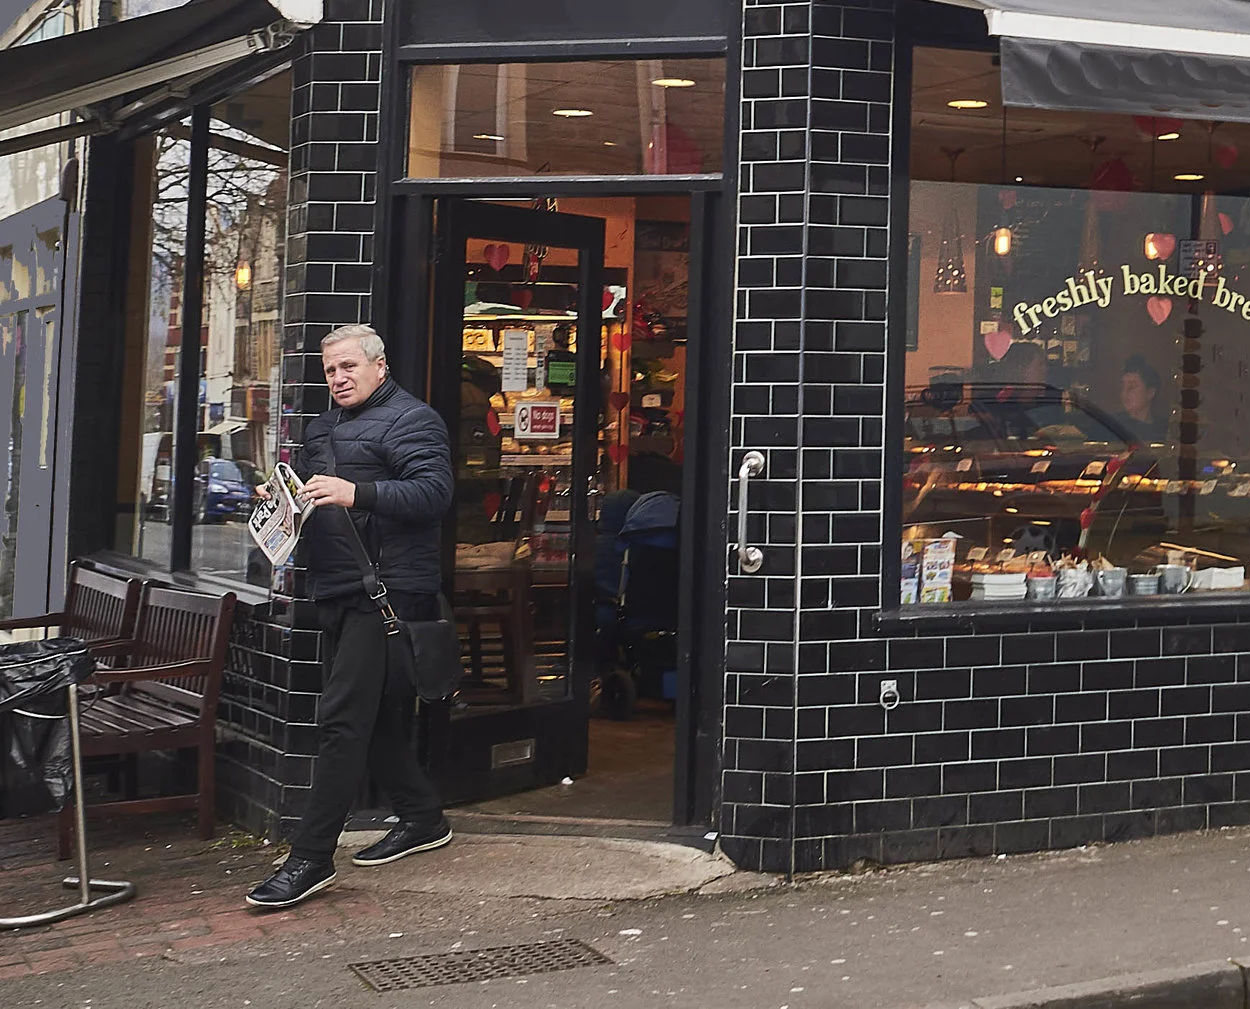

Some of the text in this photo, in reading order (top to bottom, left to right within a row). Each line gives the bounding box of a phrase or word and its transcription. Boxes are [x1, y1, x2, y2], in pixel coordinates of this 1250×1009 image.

[1013, 271, 1114, 335] freshly
[1120, 264, 1208, 300] baked
[252, 504, 272, 529] Park
